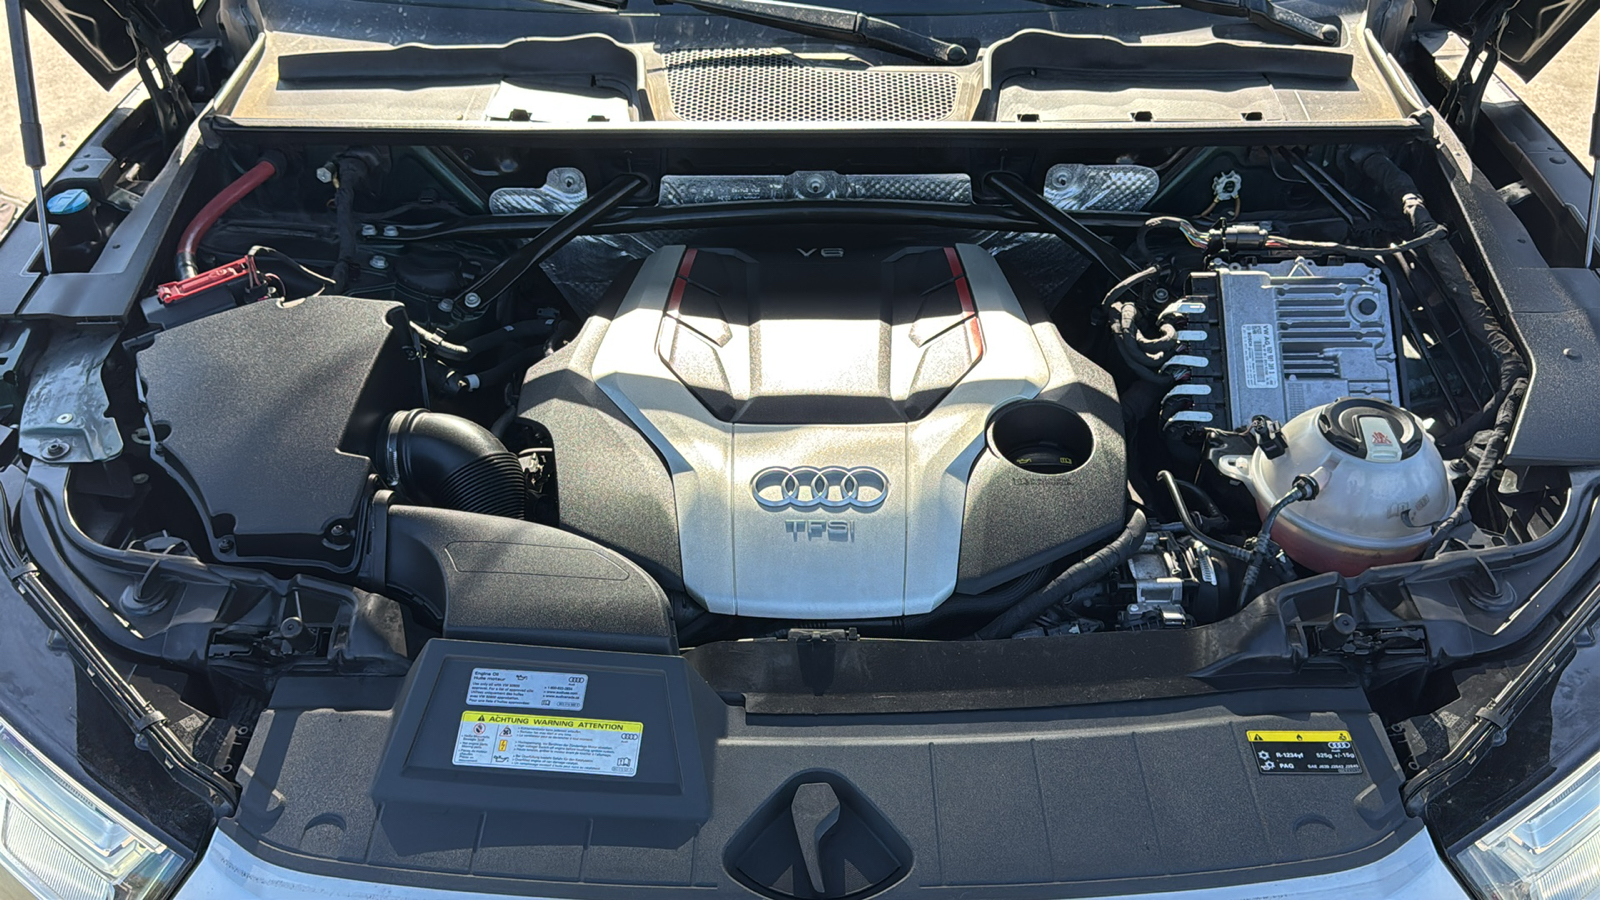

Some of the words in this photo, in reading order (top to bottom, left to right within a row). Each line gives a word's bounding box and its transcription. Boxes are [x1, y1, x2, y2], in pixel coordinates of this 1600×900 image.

[796, 247, 844, 257] V6
[489, 716, 529, 724] ACHTUNG
[533, 718, 574, 728] WARNING
[577, 721, 624, 731] ATTENTION
